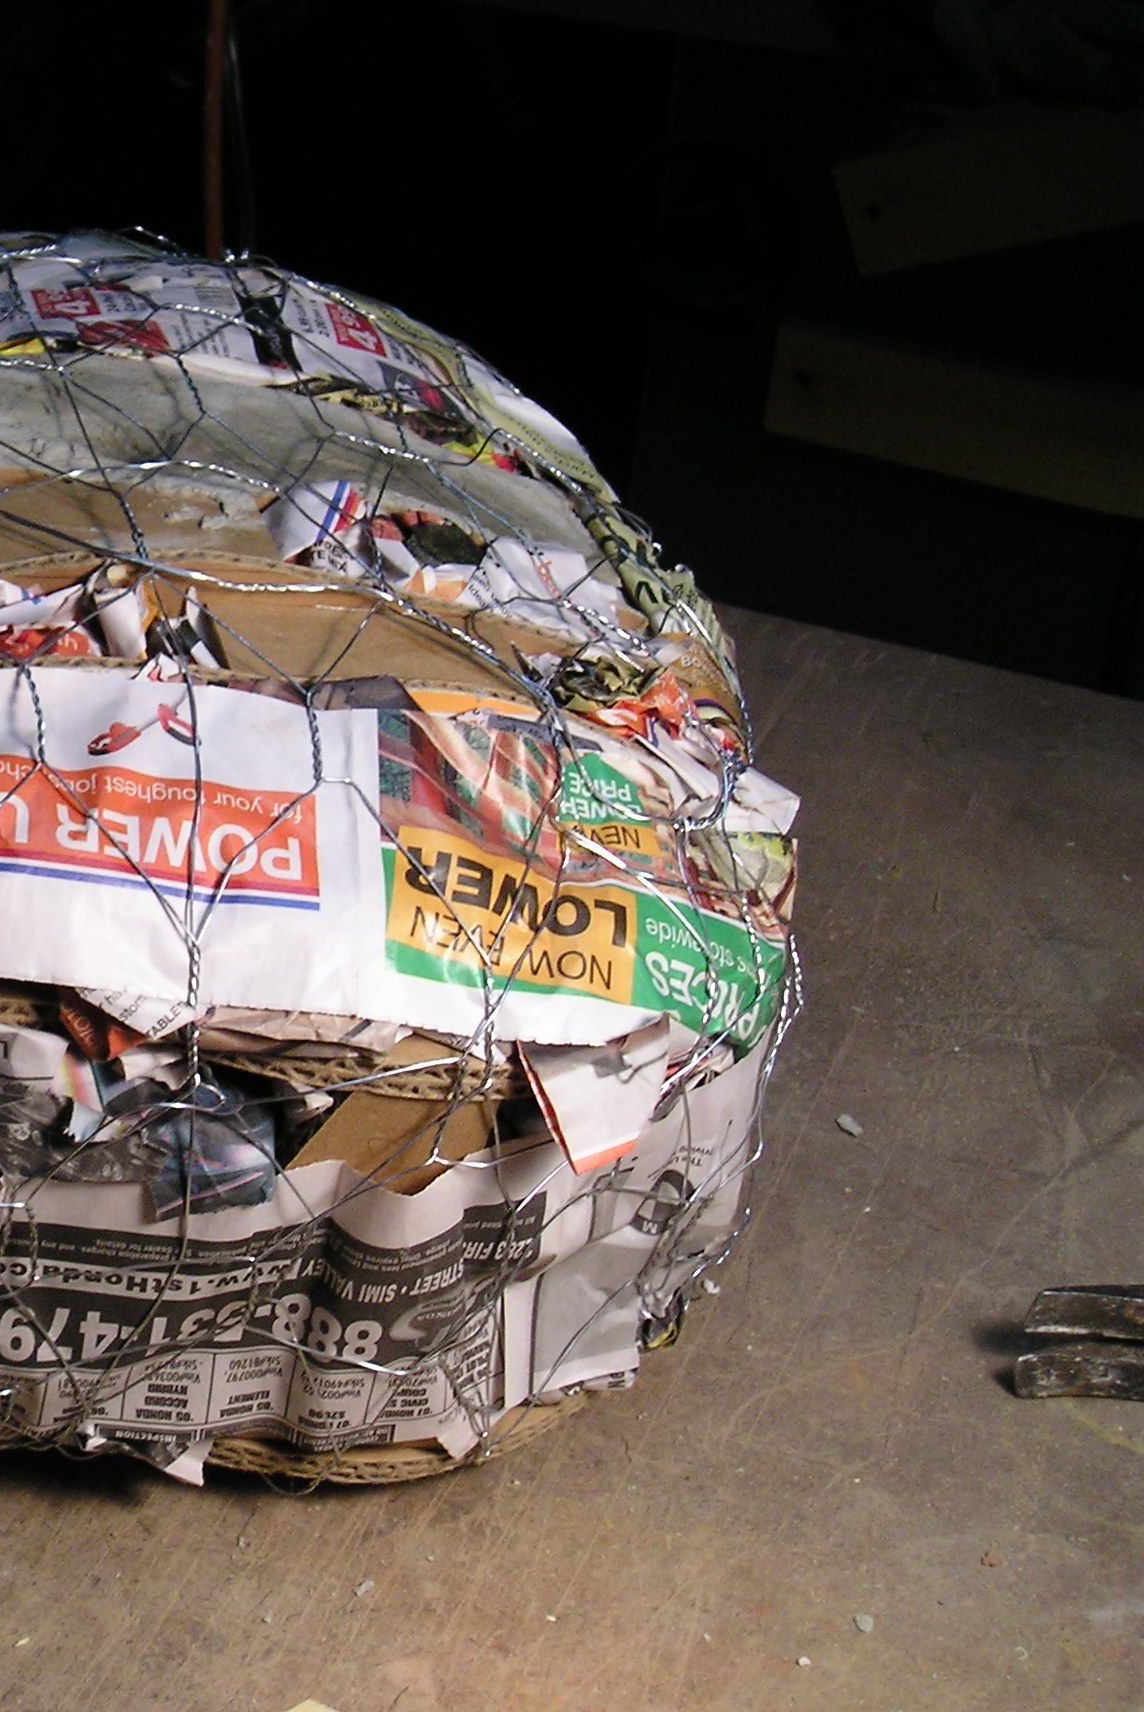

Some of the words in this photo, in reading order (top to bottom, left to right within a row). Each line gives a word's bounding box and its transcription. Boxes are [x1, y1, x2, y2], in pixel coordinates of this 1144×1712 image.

[104, 775, 205, 805] toughest
[568, 772, 632, 801] PRICE
[214, 790, 263, 812] your
[273, 801, 302, 824] for
[53, 801, 304, 881] POWER
[405, 844, 628, 948] LOWER
[409, 905, 505, 967] EVEN
[525, 948, 613, 991] NOW
[644, 949, 760, 1041] PRICES
[301, 1258, 354, 1300] VALLEY
[409, 1258, 463, 1296] STREET
[358, 1283, 397, 1302] SIMI
[144, 1396, 188, 1409] ACCORD
[147, 1384, 188, 1395] HYBRID
[228, 1391, 269, 1405] ELEMENT
[135, 1408, 172, 1420] HONDA
[220, 1404, 253, 1418] HONDA
[114, 1430, 177, 1442] INSPECTION
